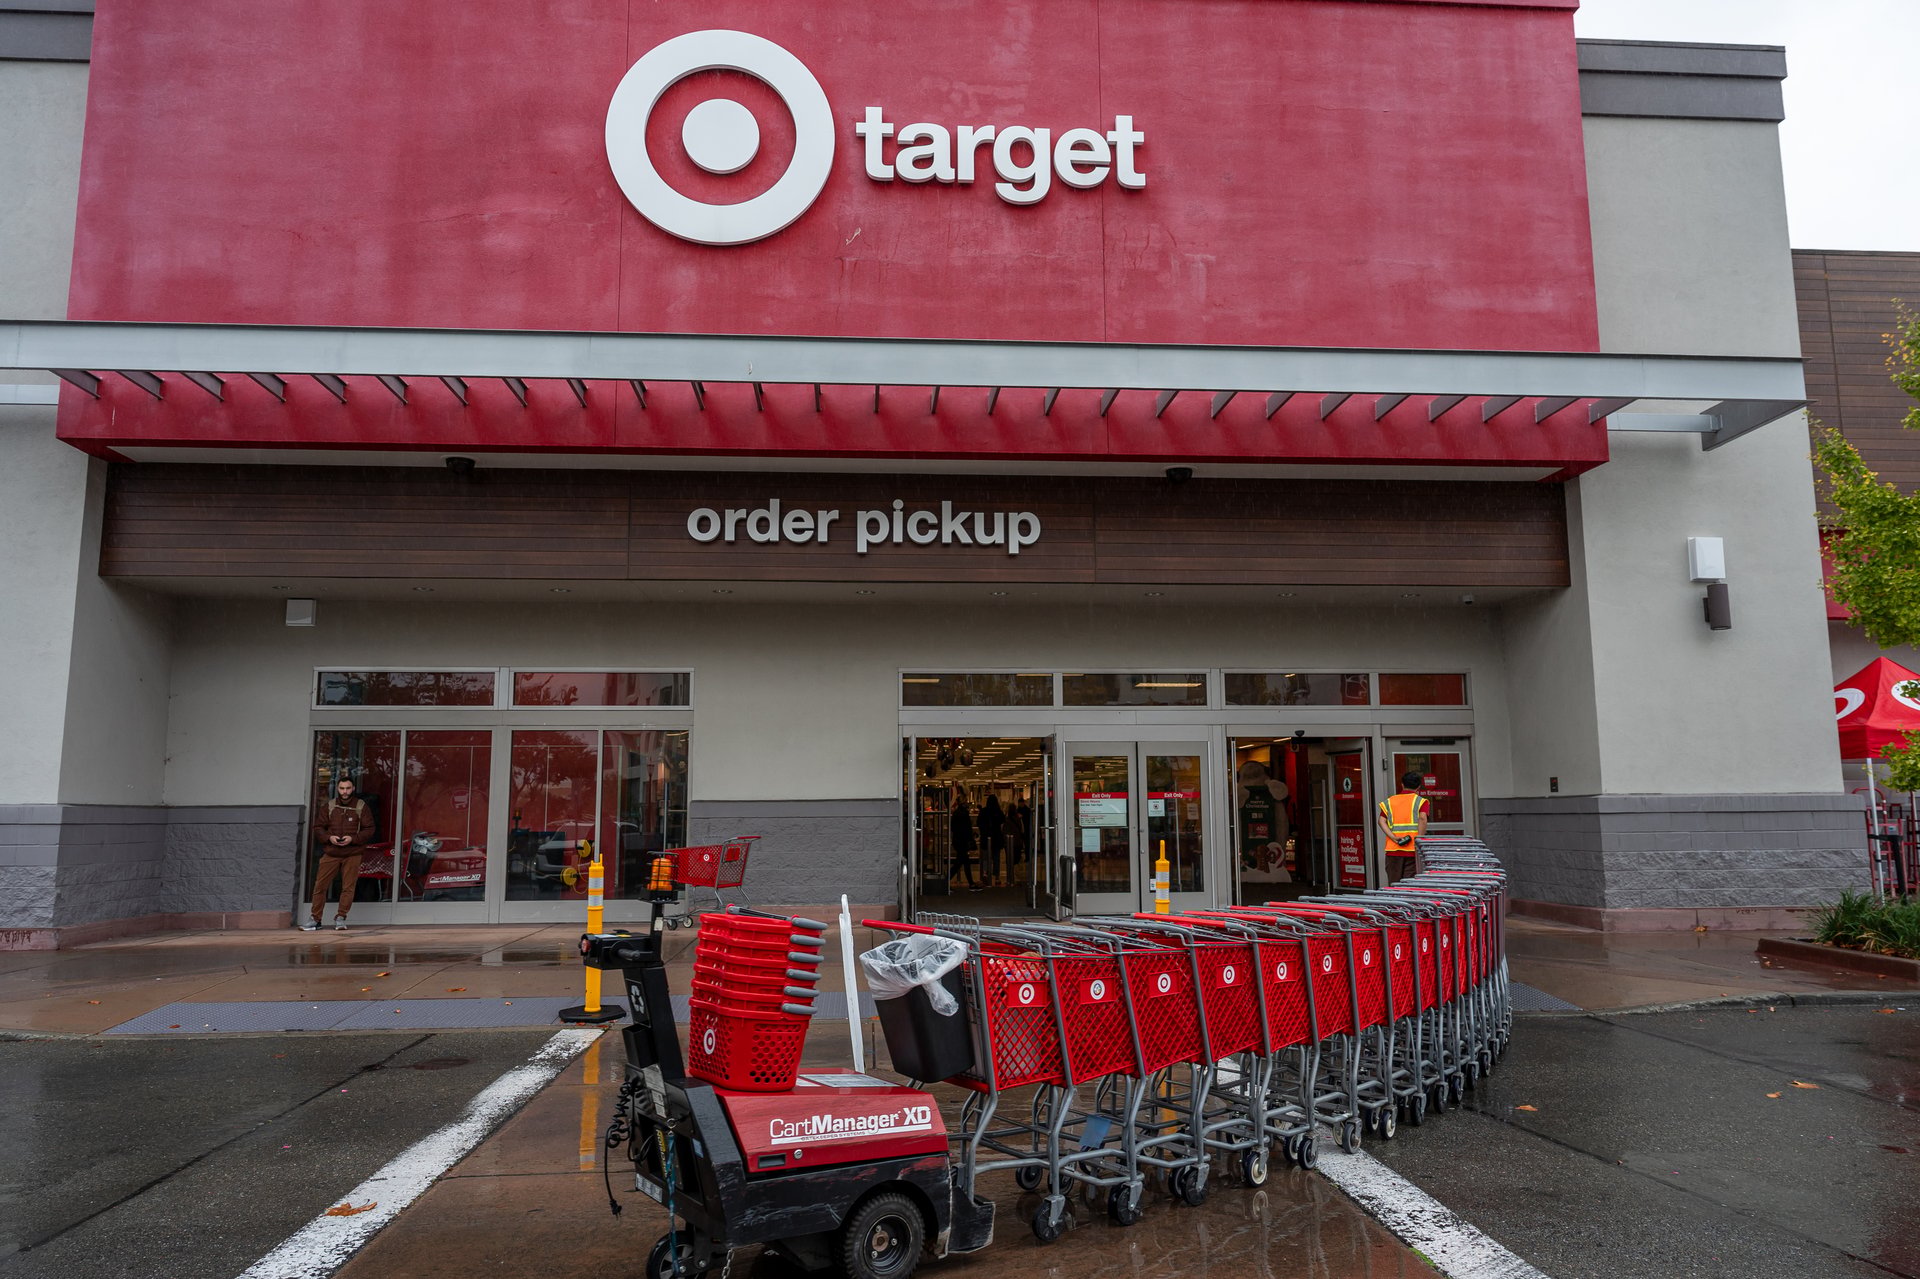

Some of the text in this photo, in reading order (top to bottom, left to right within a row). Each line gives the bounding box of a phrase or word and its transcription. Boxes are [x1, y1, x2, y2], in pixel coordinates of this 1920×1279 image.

[855, 106, 1146, 205] target
[687, 498, 1042, 554] order pickup
[1340, 836, 1355, 846] hiring
[1341, 846, 1358, 855] holiday
[1341, 855, 1360, 863] helpers
[769, 1105, 932, 1138] CartManager XD
[838, 1130, 866, 1138] SYSTEMS
